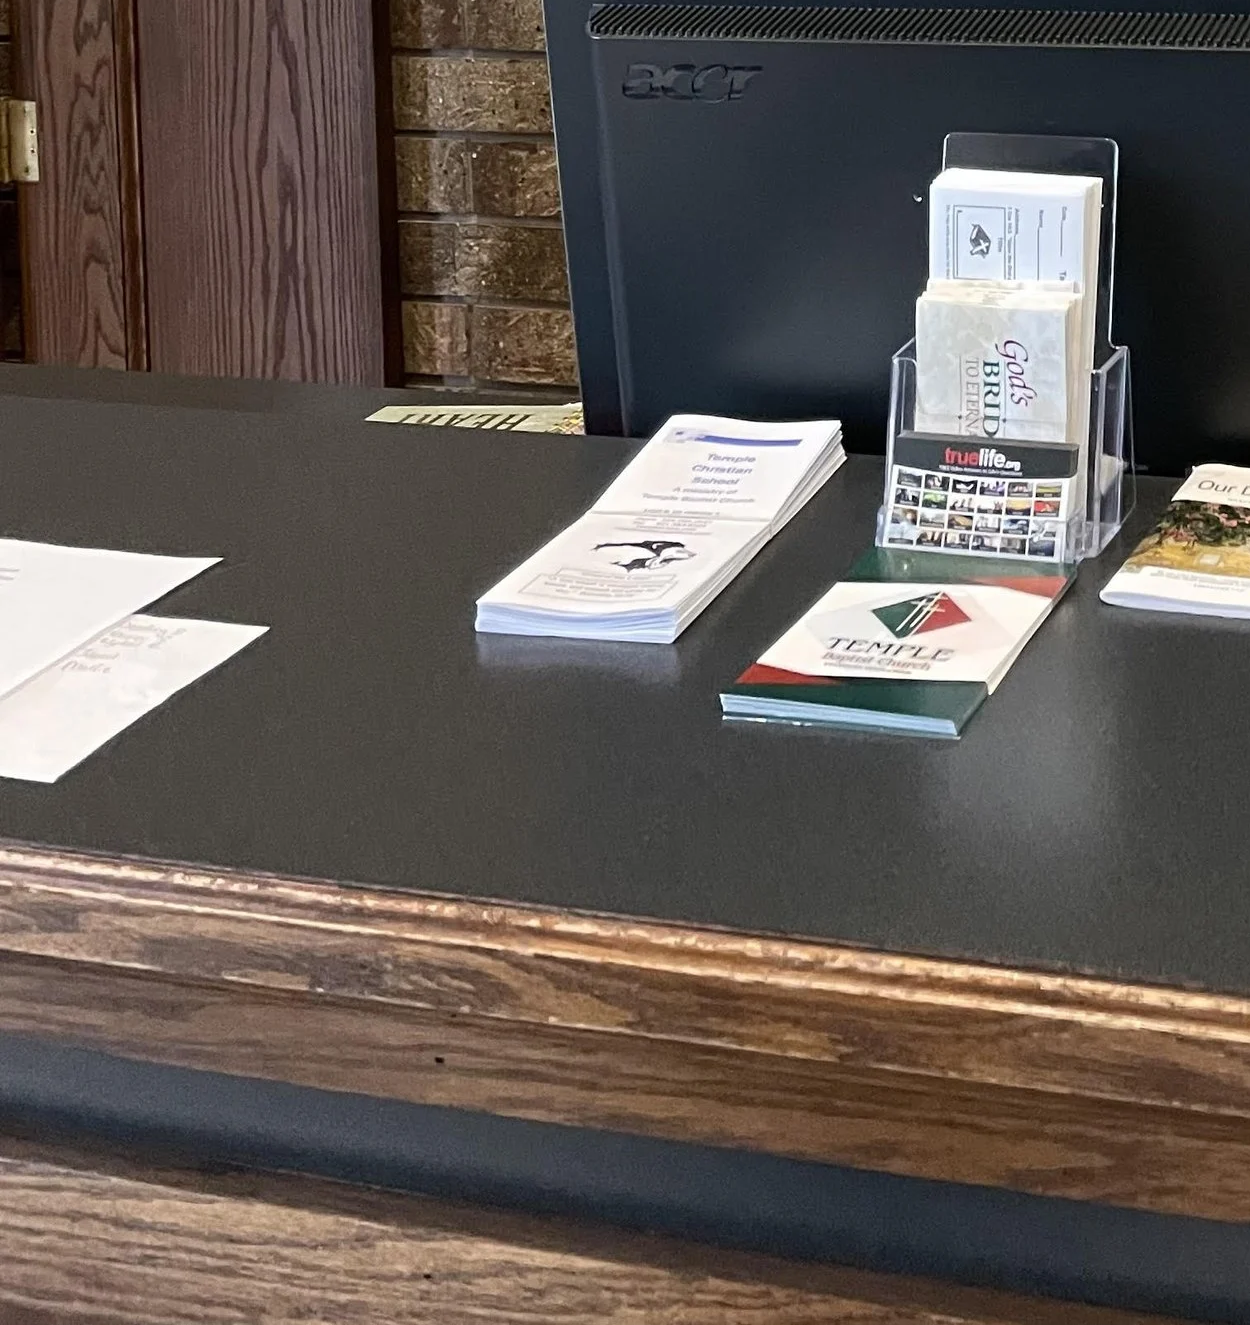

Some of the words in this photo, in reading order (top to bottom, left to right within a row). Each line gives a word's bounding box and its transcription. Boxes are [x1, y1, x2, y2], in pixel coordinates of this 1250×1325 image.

[622, 62, 763, 104] acer
[966, 358, 980, 378] TO
[995, 339, 1038, 408] God's
[982, 360, 1000, 439] BRID
[707, 452, 757, 464] Temple
[944, 447, 1021, 471] truelife.org
[691, 464, 753, 475] Christian
[691, 476, 741, 486] School
[1198, 479, 1237, 493] Our
[827, 636, 956, 662] TEMPLE
[821, 652, 876, 665] Baptist
[877, 656, 932, 671] Church
